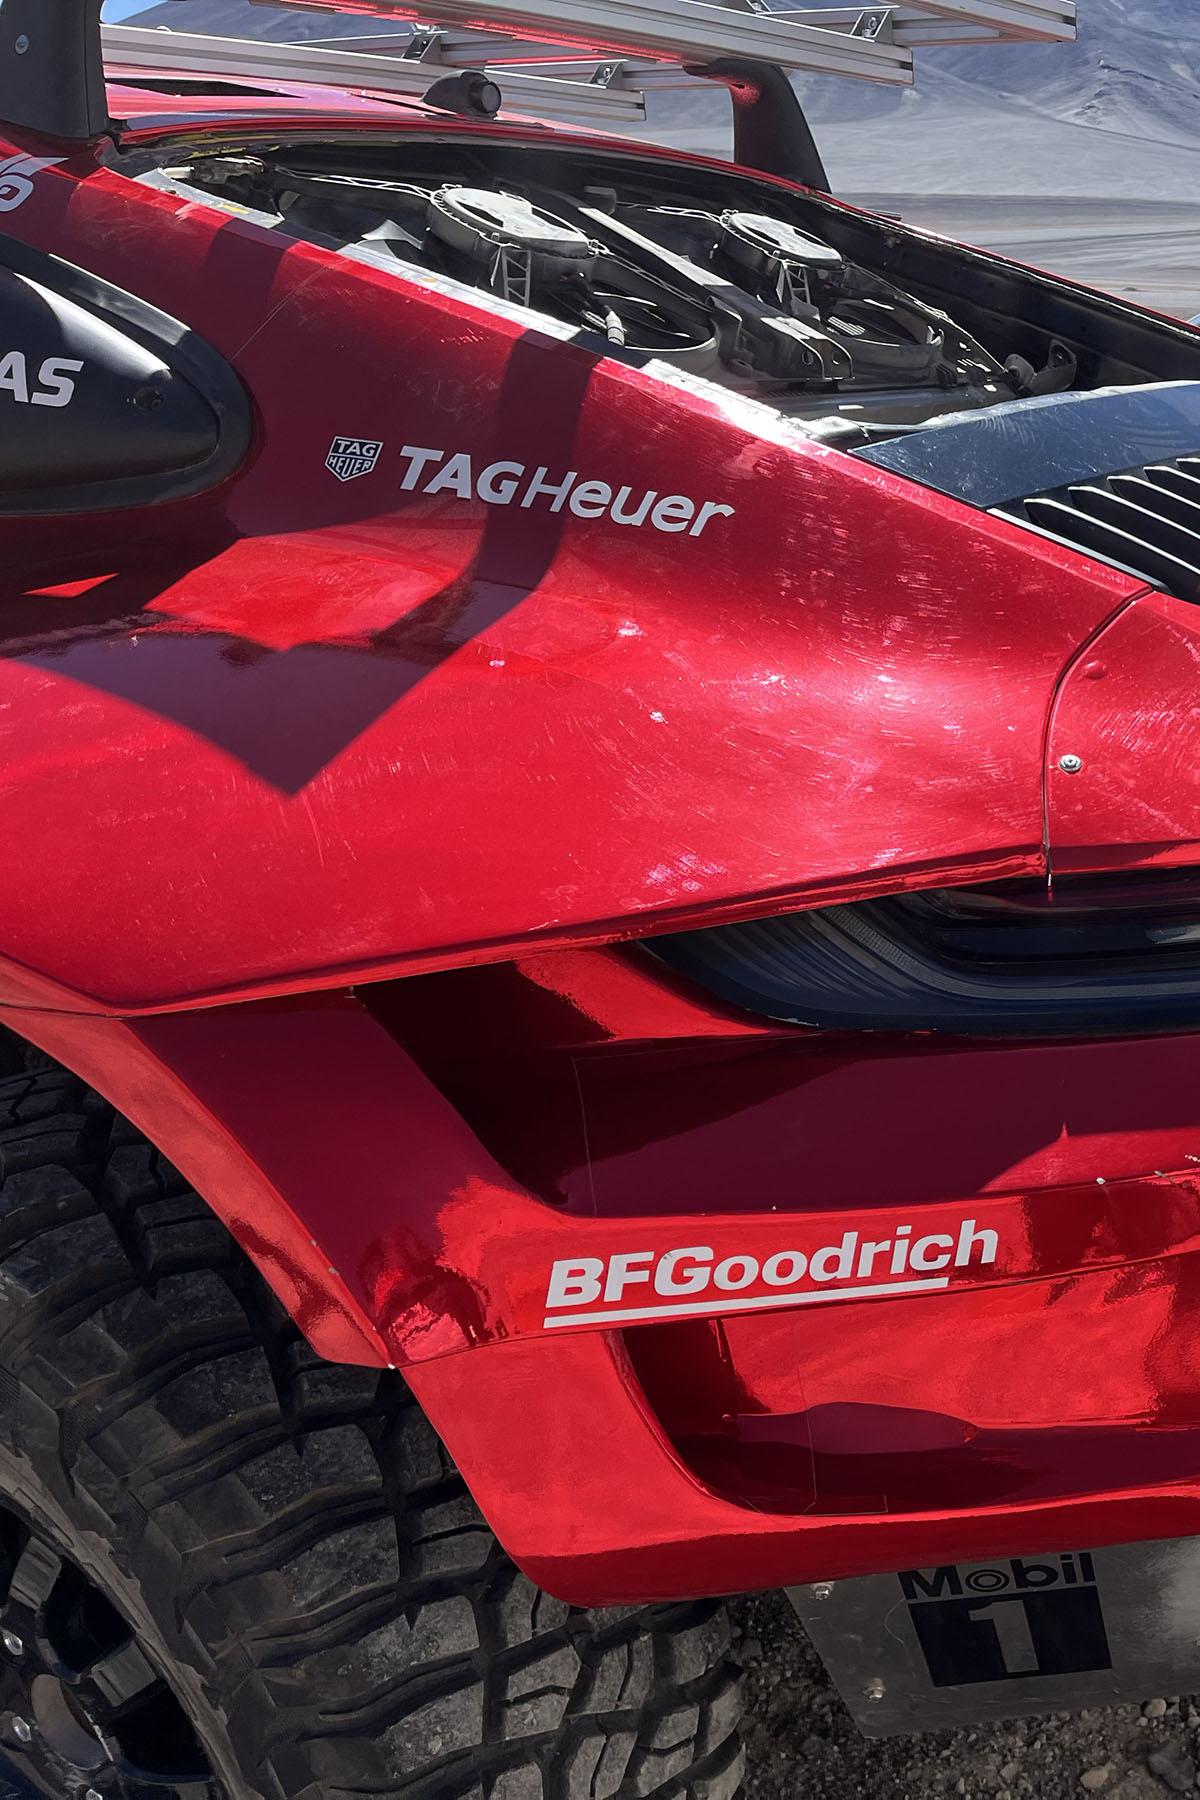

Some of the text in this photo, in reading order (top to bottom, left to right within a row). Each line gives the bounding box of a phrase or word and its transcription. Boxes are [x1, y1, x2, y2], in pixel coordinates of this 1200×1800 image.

[329, 457, 371, 477] HEUER
[337, 440, 376, 456] TAG
[545, 1219, 999, 1309] BFGoodrich
[897, 1552, 1096, 1600] Mobil
[968, 1599, 1040, 1673] 1
